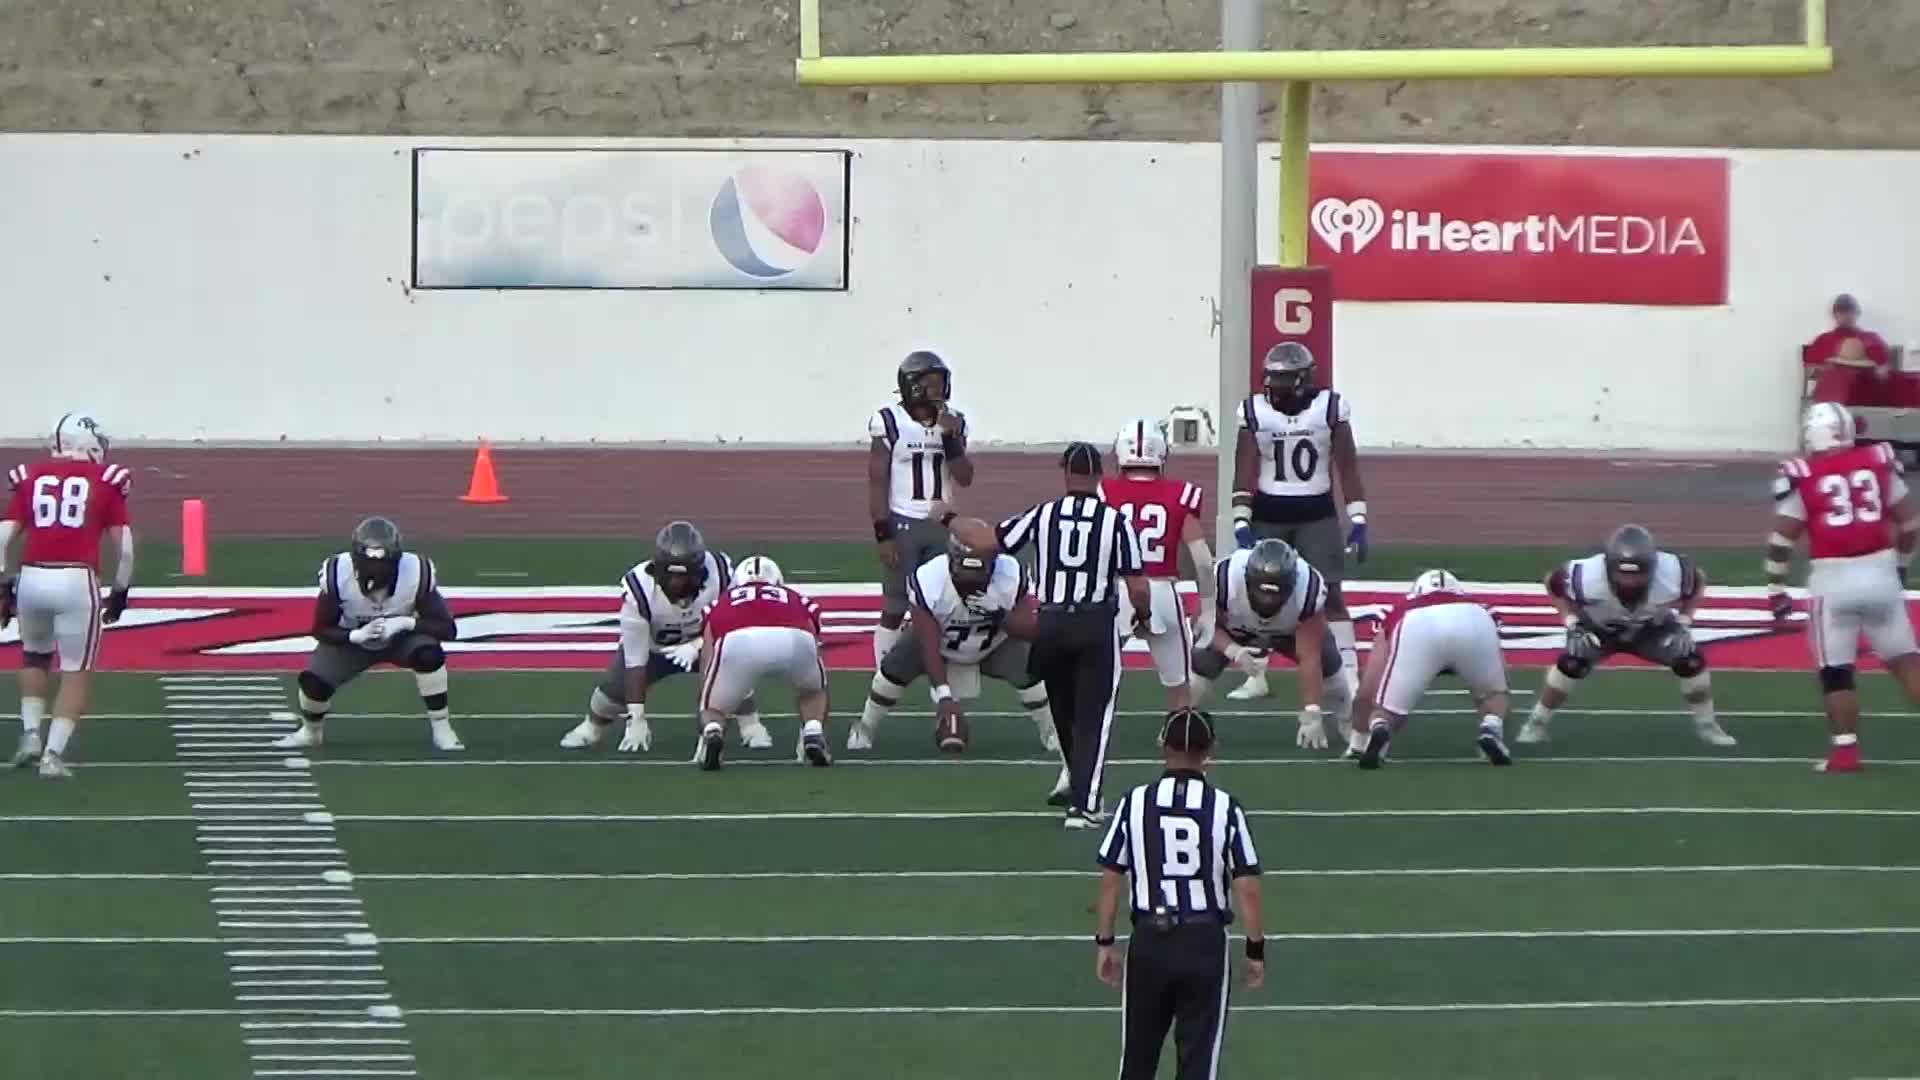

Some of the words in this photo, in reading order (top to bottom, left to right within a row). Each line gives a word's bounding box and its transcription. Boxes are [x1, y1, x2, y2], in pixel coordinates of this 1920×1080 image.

[441, 188, 682, 262] pepsi
[1391, 209, 1706, 255] iHeartMEDIA
[1274, 288, 1313, 335] G
[911, 451, 944, 500] 11
[1272, 438, 1319, 481] 10
[33, 475, 89, 528] 68
[1819, 469, 1882, 527] 33
[1058, 519, 1093, 567] U
[1160, 816, 1201, 877] B
